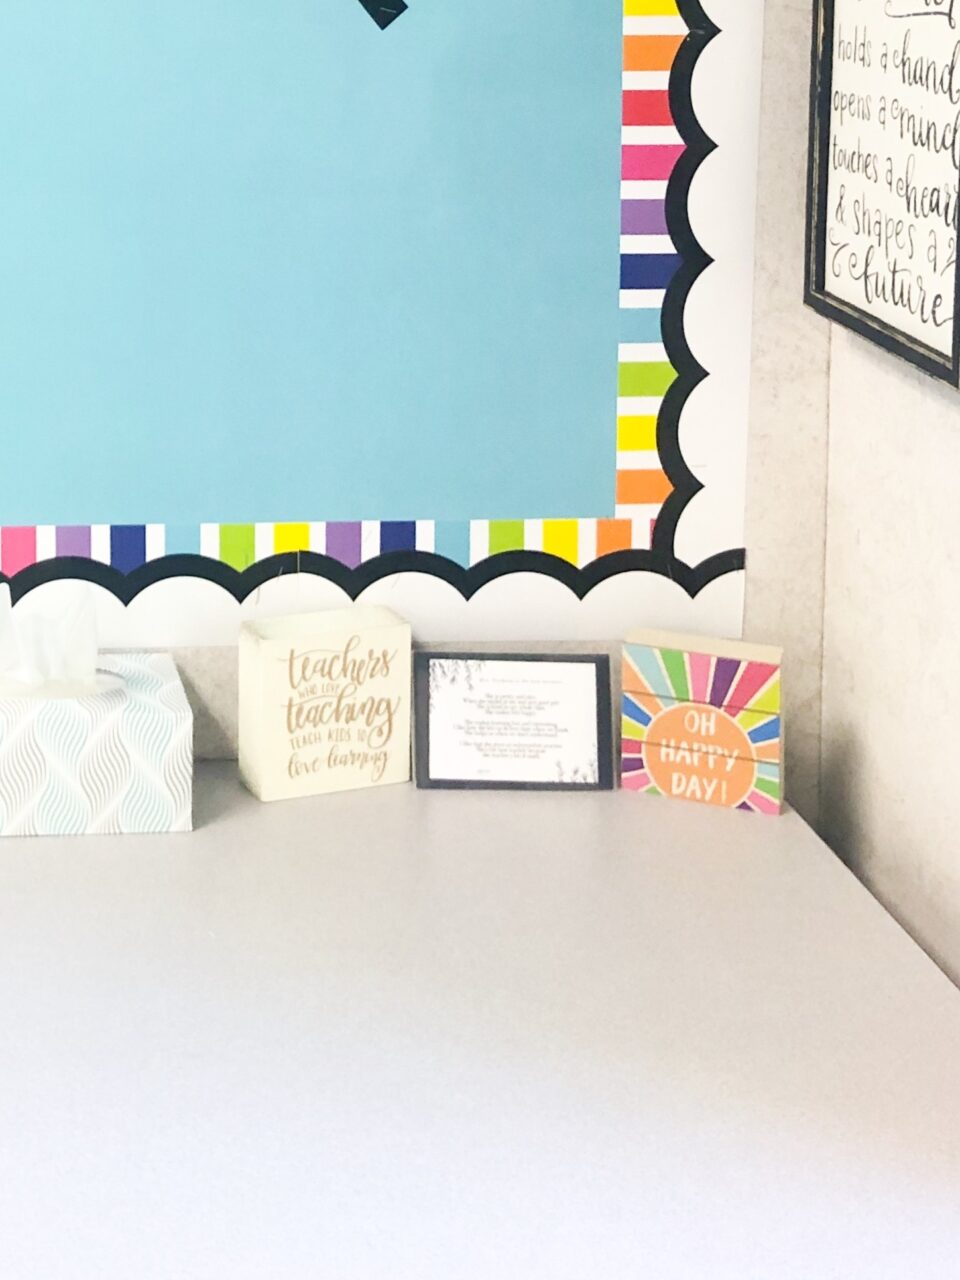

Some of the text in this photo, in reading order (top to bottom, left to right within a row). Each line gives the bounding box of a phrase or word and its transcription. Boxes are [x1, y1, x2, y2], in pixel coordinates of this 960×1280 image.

[838, 24, 872, 68] holds
[880, 42, 888, 74] a
[833, 90, 871, 126] opens
[879, 95, 886, 130] a
[833, 134, 878, 183] touches
[885, 157, 893, 192] a
[836, 184, 938, 273] & shapes a
[848, 244, 954, 327] future
[278, 635, 398, 689] teachers
[281, 683, 401, 749] teaching
[684, 710, 716, 736] OH
[288, 744, 388, 782] love learning
[660, 738, 739, 772] HAPPY
[671, 772, 727, 804] DAY!
